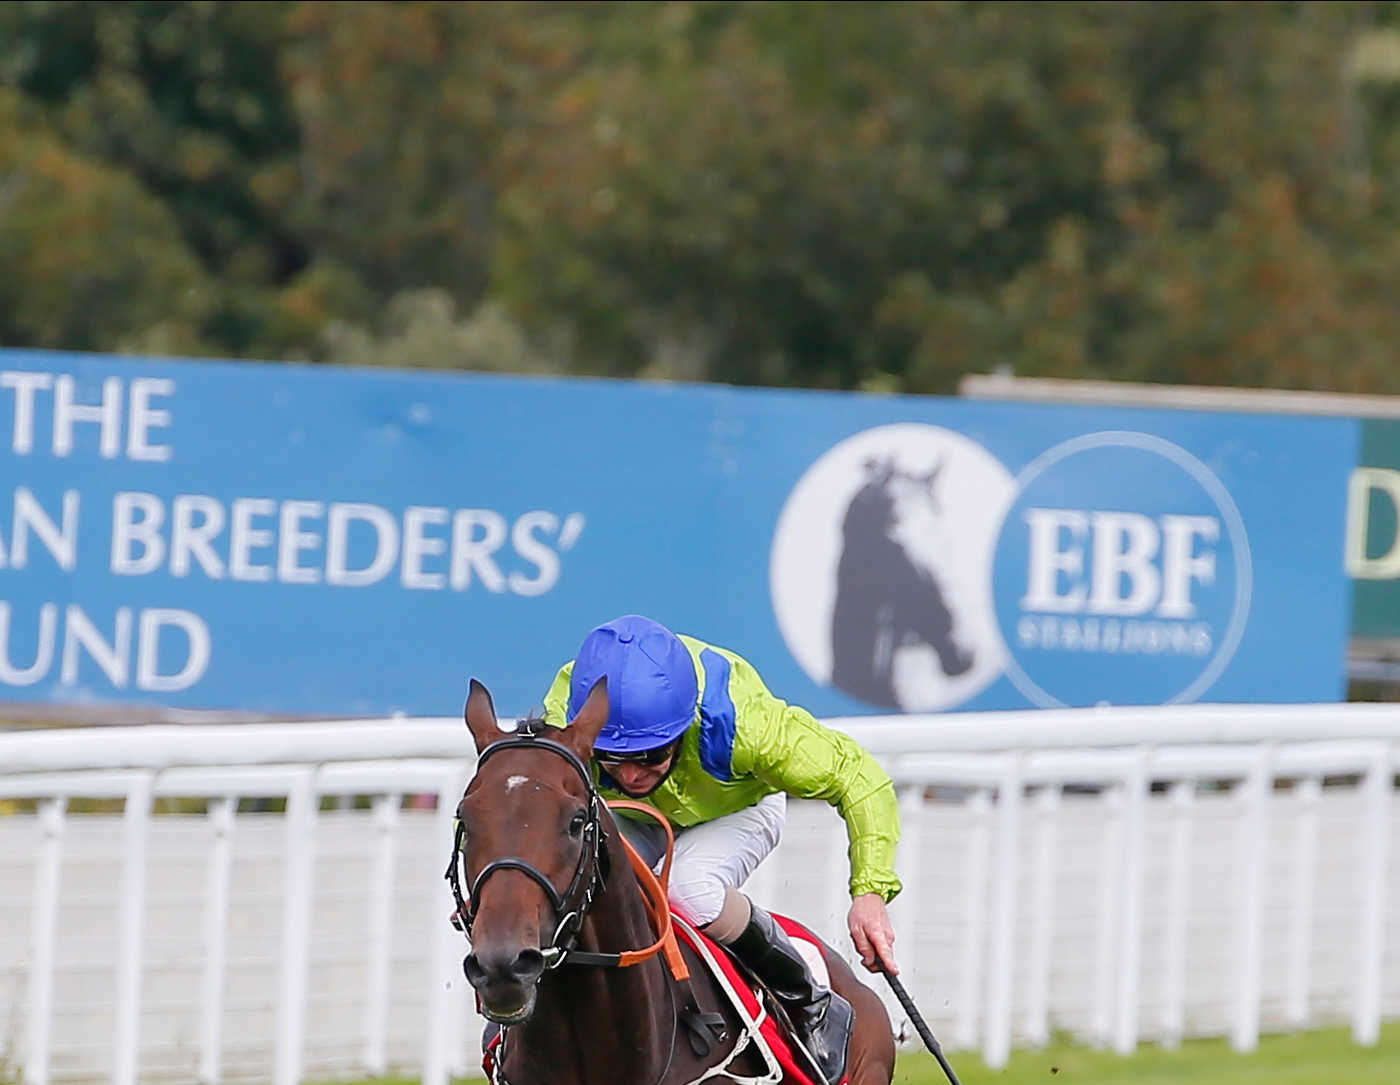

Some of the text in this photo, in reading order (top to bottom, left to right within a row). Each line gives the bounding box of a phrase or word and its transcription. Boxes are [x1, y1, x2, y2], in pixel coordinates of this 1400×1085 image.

[0, 371, 176, 463] THE
[0, 486, 81, 573] N
[1018, 508, 1220, 620] EBF
